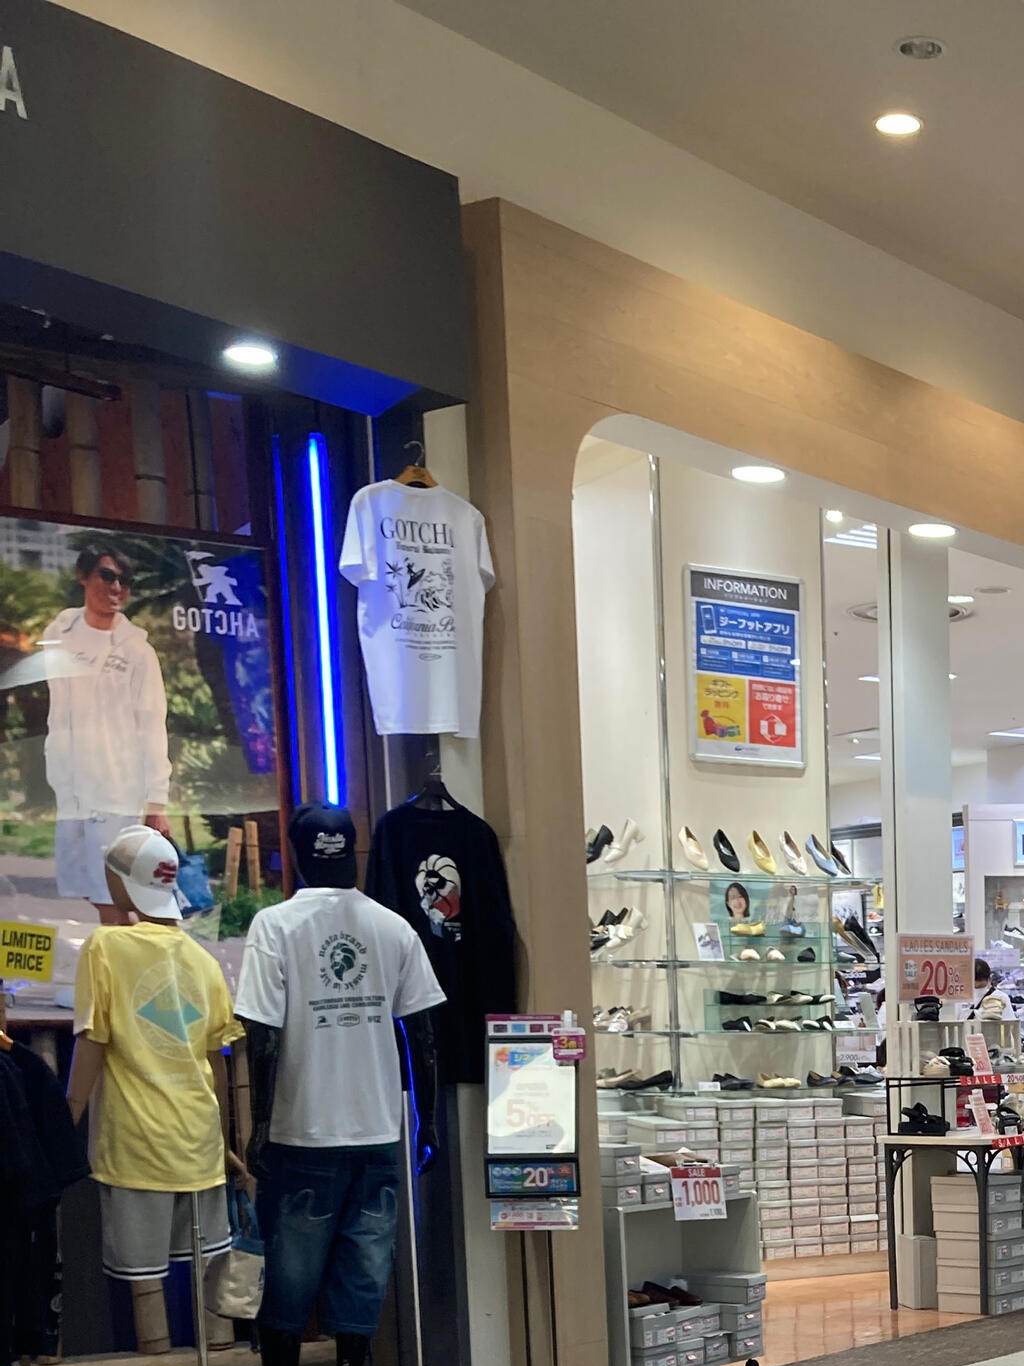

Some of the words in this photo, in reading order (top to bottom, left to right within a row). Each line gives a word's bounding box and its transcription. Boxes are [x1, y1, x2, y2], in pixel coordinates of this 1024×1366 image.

[704, 577, 787, 600] INFORMATION
[172, 604, 260, 639] GOTCHA
[719, 616, 790, 635] ジーフットアプリ
[2, 930, 51, 951] LIMITED
[6, 952, 44, 972] PRICE
[948, 985, 965, 996] OFF
[966, 1074, 997, 1086] SALE
[688, 1168, 705, 1178] SALE
[682, 1180, 720, 1207] 1,000
